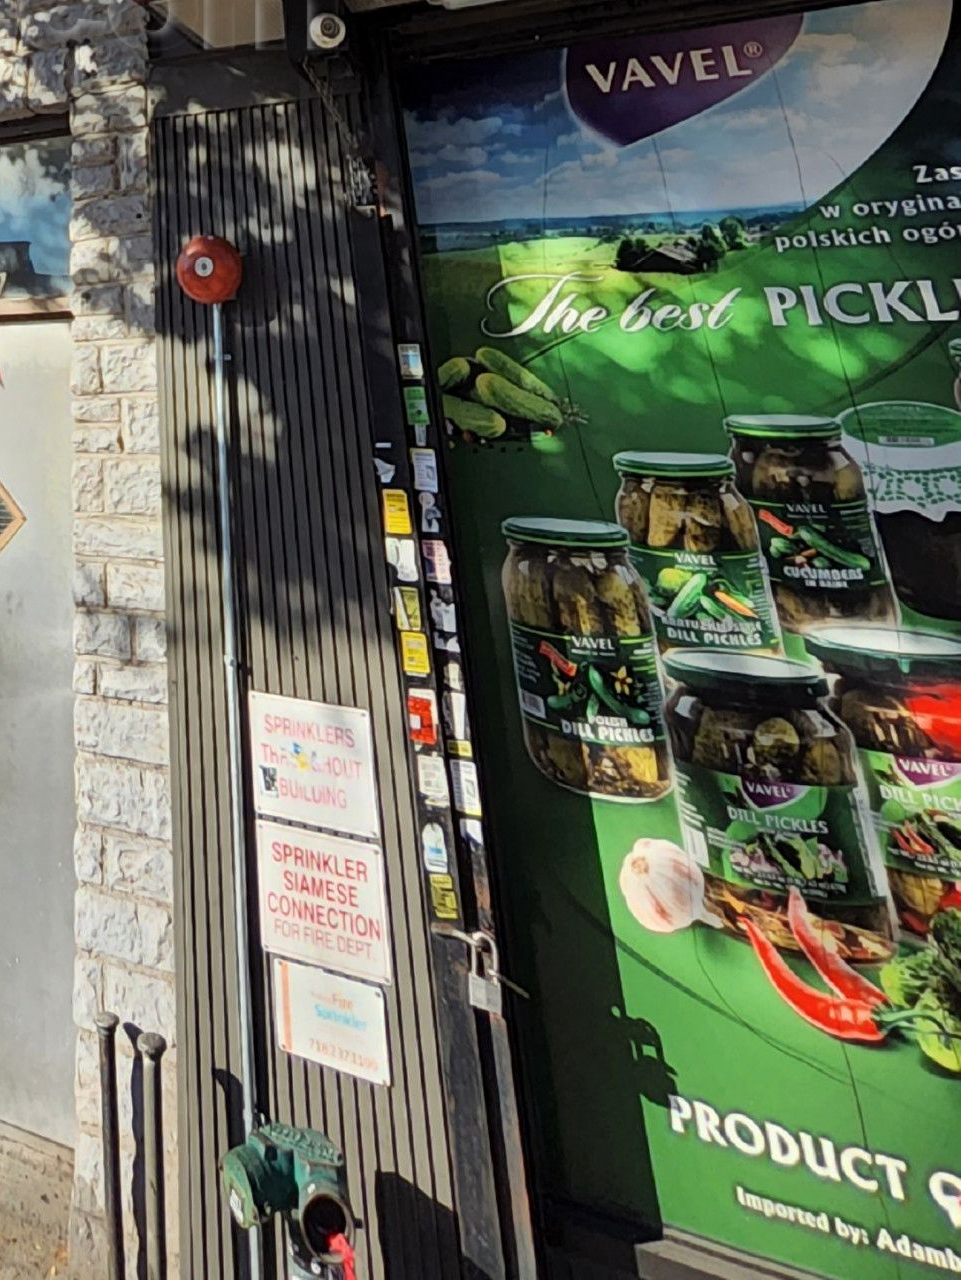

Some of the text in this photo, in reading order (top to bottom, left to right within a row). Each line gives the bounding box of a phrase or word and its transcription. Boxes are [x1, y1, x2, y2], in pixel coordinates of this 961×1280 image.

[819, 204, 840, 219] w
[774, 226, 892, 253] polskich
[481, 271, 961, 338] The best PICKL
[787, 503, 827, 514] VAVEL
[673, 552, 717, 566] VAVEL
[570, 635, 615, 650] VAVEL
[667, 627, 763, 647] DILL PICKLES
[263, 713, 356, 749] SPRINKLERS
[561, 719, 655, 743] DILL PICKLES
[879, 784, 915, 804] DILL
[727, 805, 830, 835] DILL PICKLES
[271, 841, 369, 883] SPRINKLER
[283, 870, 360, 909] SIAMESE
[268, 891, 381, 941] CONNECTION
[274, 918, 300, 941] FOR
[303, 924, 334, 950] FIRE
[668, 1093, 907, 1201] PRODUCT
[736, 1185, 830, 1233] Imported
[834, 1216, 870, 1245] by:
